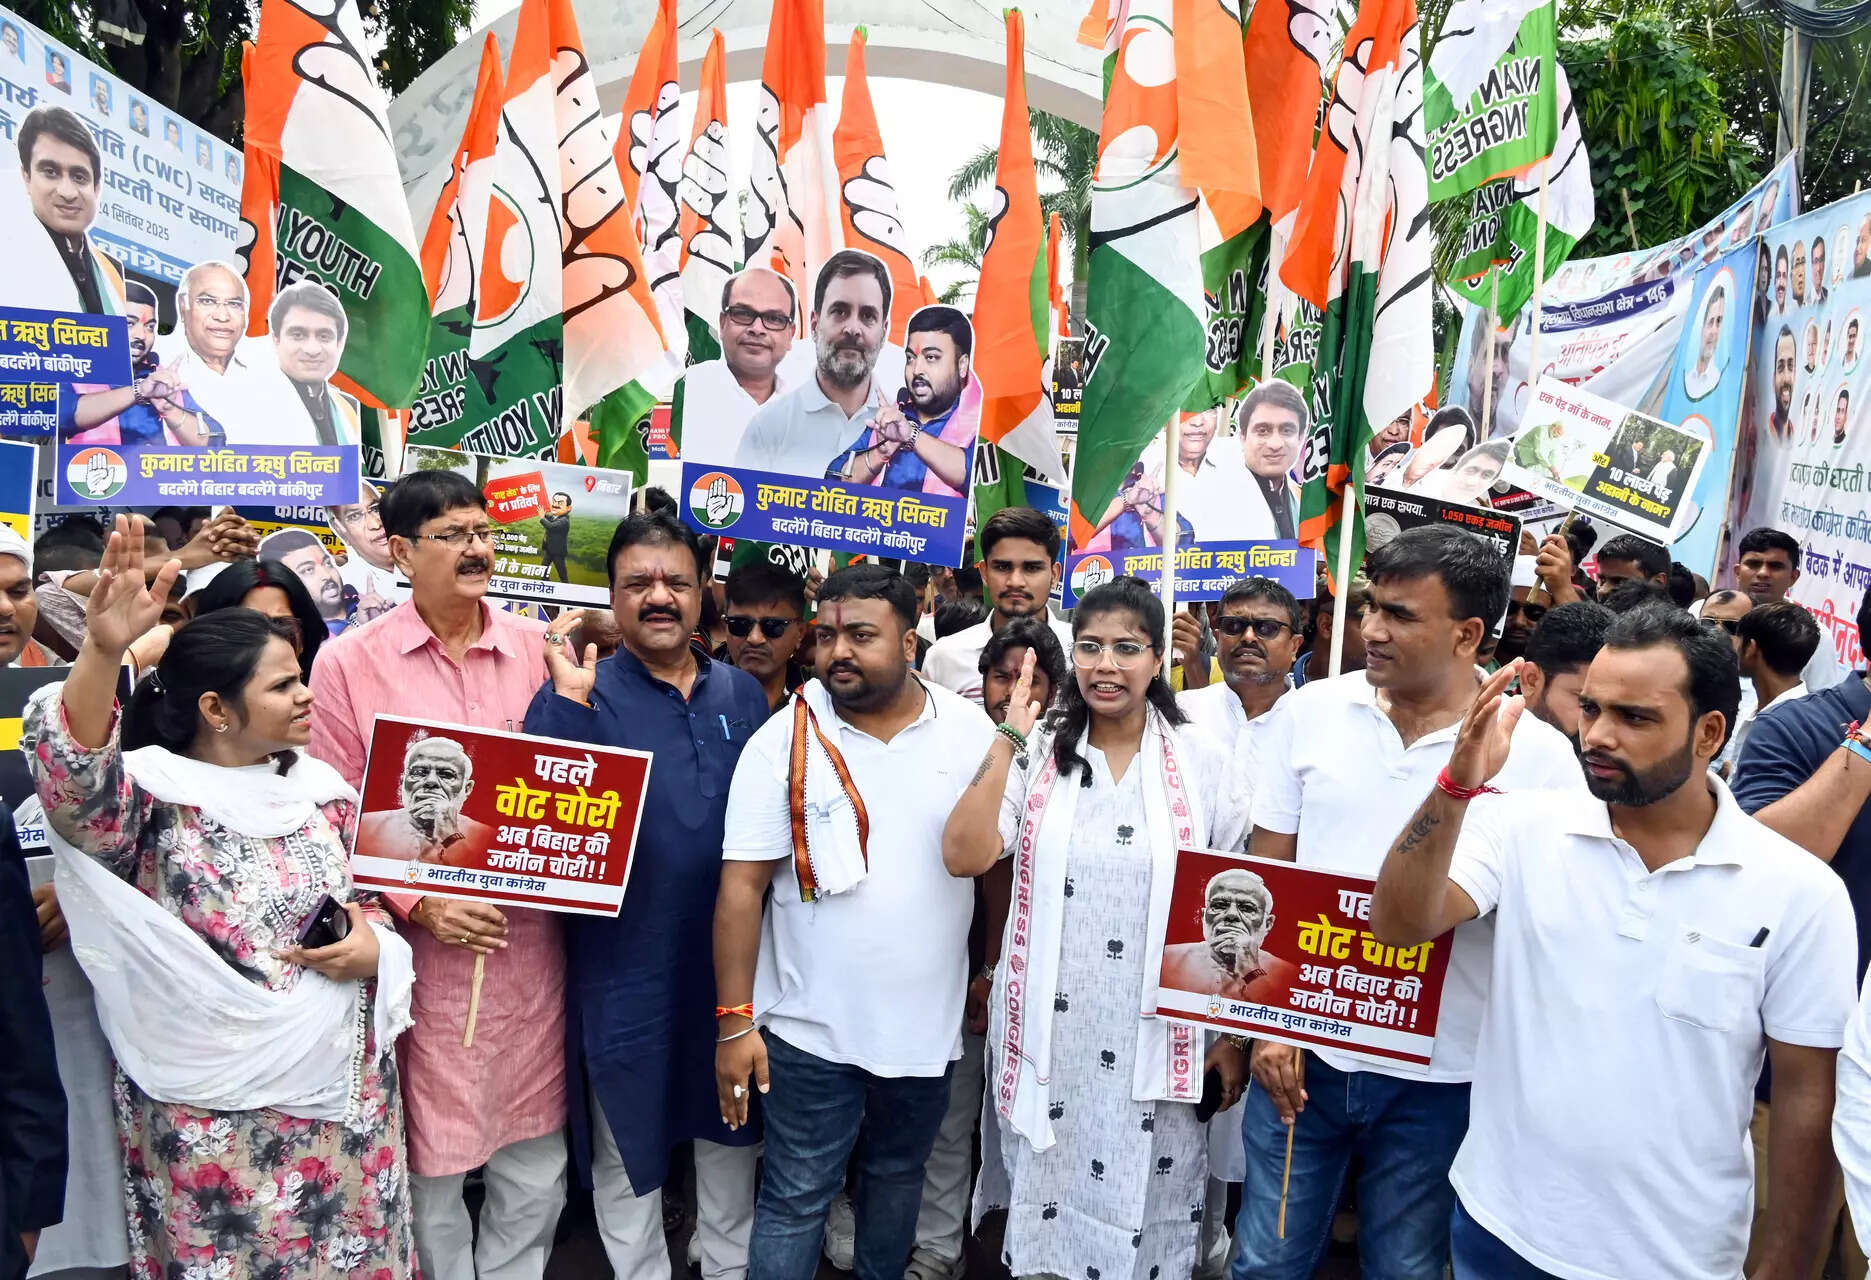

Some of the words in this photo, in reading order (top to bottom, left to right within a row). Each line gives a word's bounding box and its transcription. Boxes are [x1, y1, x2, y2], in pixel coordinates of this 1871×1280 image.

[132, 144, 193, 196] (CWC)
[157, 191, 184, 219] पर
[111, 203, 144, 232] सितंबर
[146, 219, 170, 241] 2025
[284, 211, 382, 300] YOUTH
[1646, 285, 1667, 304] 146
[13, 320, 51, 350] ऋषु
[51, 318, 108, 348] सिन्हा
[43, 354, 92, 378] बांकीपुर
[20, 410, 56, 431] बांकीपुर
[1539, 391, 1554, 404] एक
[1580, 407, 1591, 419] के
[139, 453, 195, 478] कुमार
[197, 450, 249, 474] रोहित
[251, 454, 287, 479] ऋषु
[288, 450, 341, 474] सिन्हा
[1609, 466, 1624, 482] 10
[1623, 472, 1655, 493] लाख
[1812, 460, 1830, 487] की
[1829, 463, 1864, 492] धरती
[159, 479, 199, 497] बदलेंगे
[200, 480, 237, 497] बिहार
[238, 479, 277, 497] बदलेंगे
[279, 481, 324, 499] बांकीपुर
[1381, 497, 1396, 510] एक
[1545, 481, 1576, 500] भारतीय
[1596, 481, 1630, 502] अडानी
[1629, 491, 1642, 506] के
[1641, 498, 1671, 519] नाम?
[756, 484, 806, 511] कुमार
[811, 486, 857, 516] रोहित
[861, 497, 894, 526] ऋषु
[897, 493, 948, 528] सिन्हा
[1811, 504, 1844, 538] कांग्रेस
[772, 516, 809, 536] बदलेंगे
[810, 518, 843, 541] बिहार
[845, 526, 880, 546] बदलेंगे
[883, 530, 927, 554] बांकीपुर
[1215, 551, 1246, 573] ऋषु
[1249, 546, 1298, 569] सिन्हा
[1805, 543, 1830, 578] बैठक
[1832, 549, 1844, 582] में
[500, 580, 520, 593] युवा
[522, 580, 554, 594] कांग्रेस
[534, 753, 598, 786] पहले
[496, 777, 551, 820] वोट
[554, 786, 622, 830] चोरी
[496, 825, 531, 847] अब
[531, 826, 582, 852] बिहार
[584, 832, 611, 856] की
[427, 866, 477, 883] भारतीय
[479, 874, 503, 890] युवा
[505, 875, 547, 892] कांग्रेस
[487, 848, 545, 874] जमीन
[547, 852, 607, 881] चोरी!!
[1013, 819, 1034, 946] CONGRESS
[1338, 889, 1371, 918] पह
[1297, 913, 1354, 960] वोट
[1298, 963, 1335, 989] अब
[1336, 966, 1392, 997] बिहार
[1394, 976, 1423, 1002] की
[1229, 1003, 1279, 1022] भारतीय
[1281, 1012, 1307, 1029] युवा
[1309, 1017, 1353, 1037] कांग्रेस
[1289, 987, 1350, 1018] जमीन
[1354, 996, 1418, 1029] चोरी!!
[997, 980, 1021, 1101] CONGRESS
